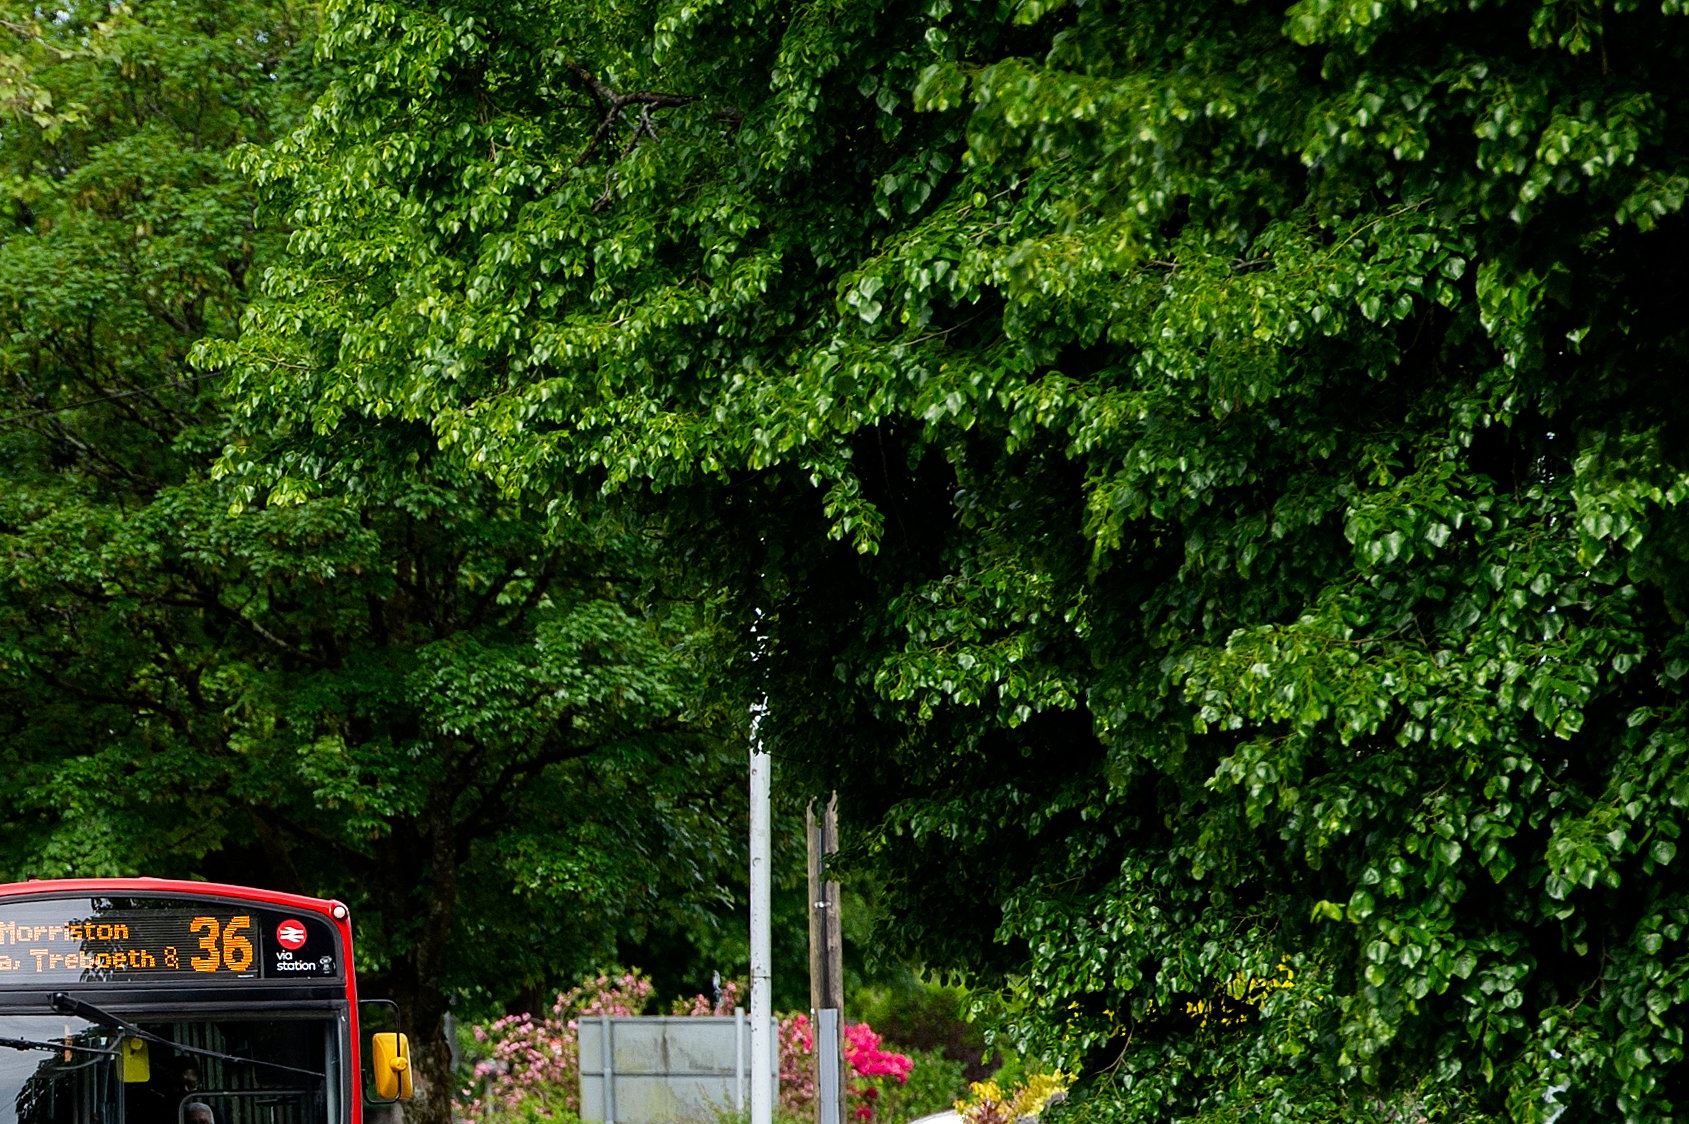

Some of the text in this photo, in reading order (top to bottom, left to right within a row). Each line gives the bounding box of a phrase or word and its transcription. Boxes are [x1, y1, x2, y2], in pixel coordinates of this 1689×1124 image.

[189, 915, 253, 972] 36
[29, 948, 156, 973] Treboeth
[164, 946, 179, 969] &
[276, 949, 293, 961] via
[276, 959, 316, 971] station
